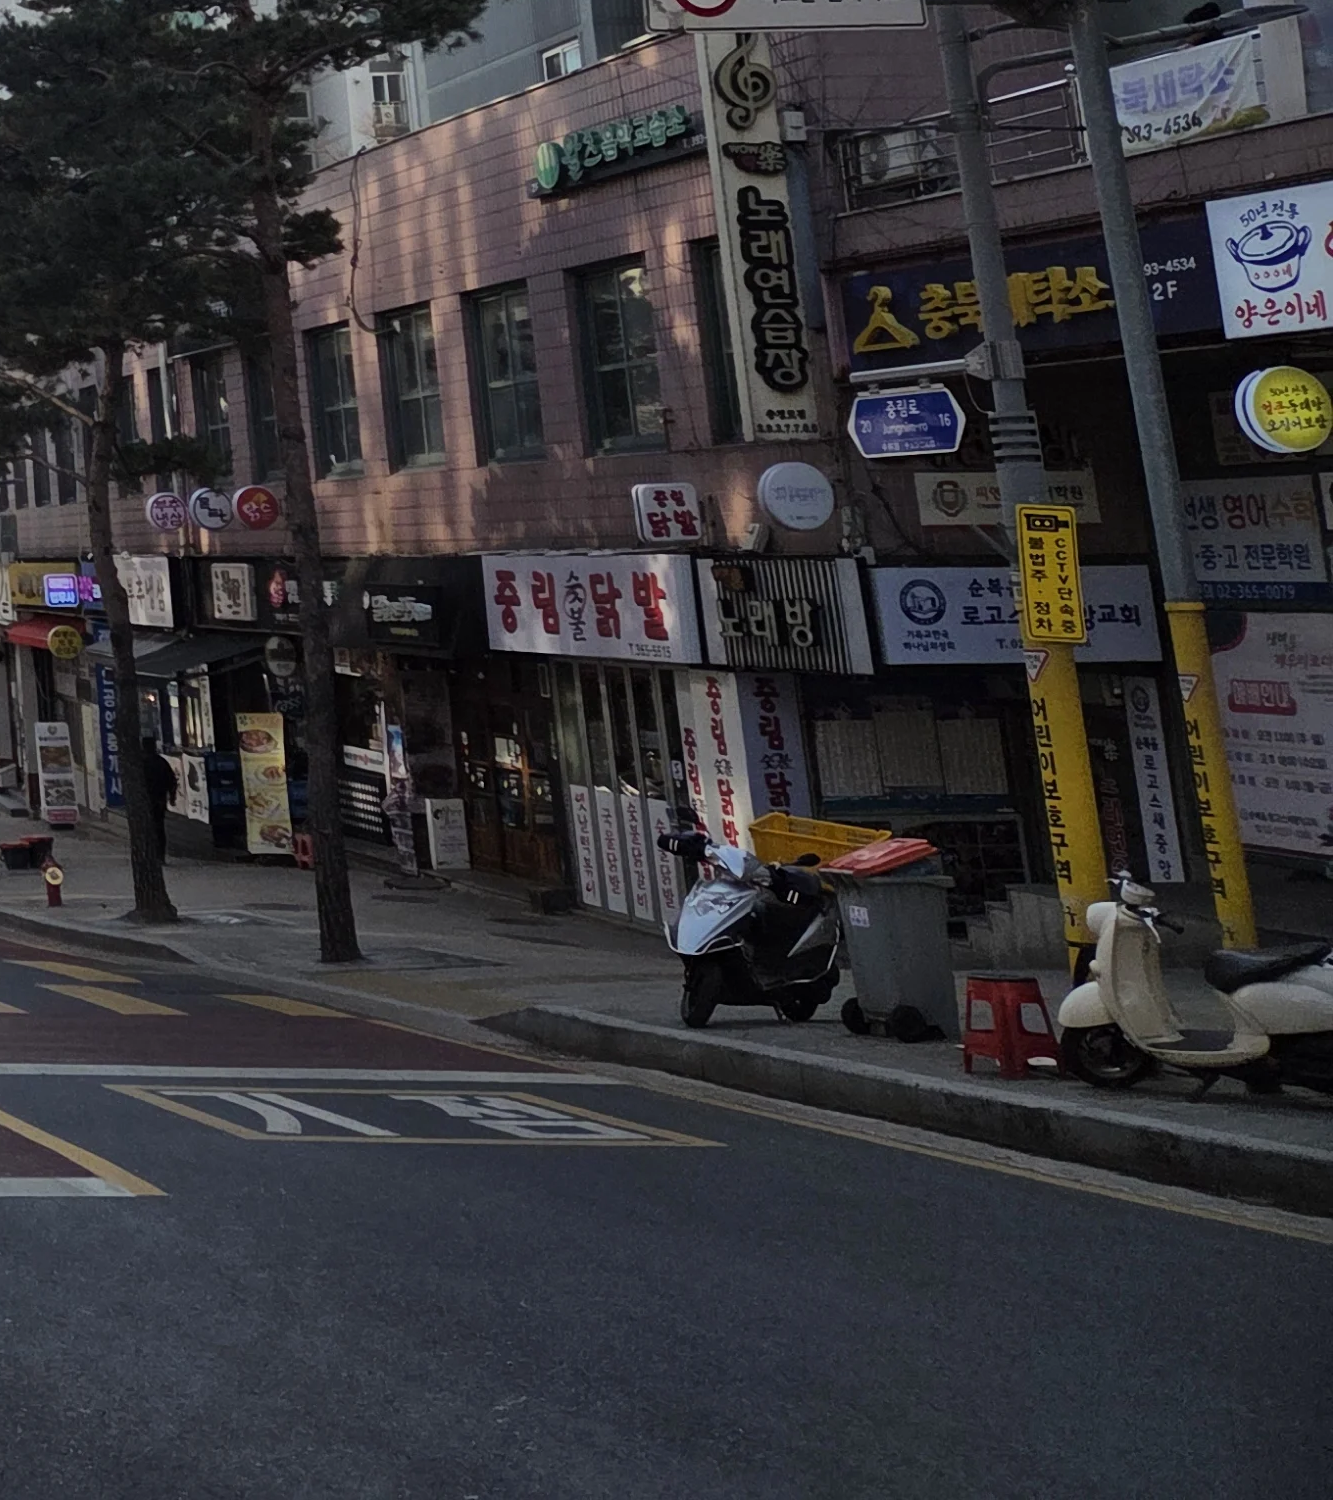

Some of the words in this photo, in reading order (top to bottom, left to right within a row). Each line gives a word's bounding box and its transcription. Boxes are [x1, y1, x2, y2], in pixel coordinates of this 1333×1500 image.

[1115, 56, 1236, 113] 북세탁소
[1240, 203, 1268, 225] 50년
[745, 188, 803, 387] 노래연습장
[1152, 281, 1178, 301] 2F
[1235, 291, 1327, 329] 양은이네
[886, 399, 920, 419] 중림로
[939, 412, 951, 427] 16
[860, 420, 872, 433] 20
[654, 489, 686, 508] 중림
[1222, 494, 1270, 529] 영어
[646, 509, 699, 538] 닭발
[1243, 543, 1312, 570] 전문학원
[494, 570, 560, 634] 중림
[589, 571, 669, 641] 닭발
[719, 599, 813, 648] 노래방
[705, 675, 728, 756] 중림
[754, 676, 784, 751] 중림
